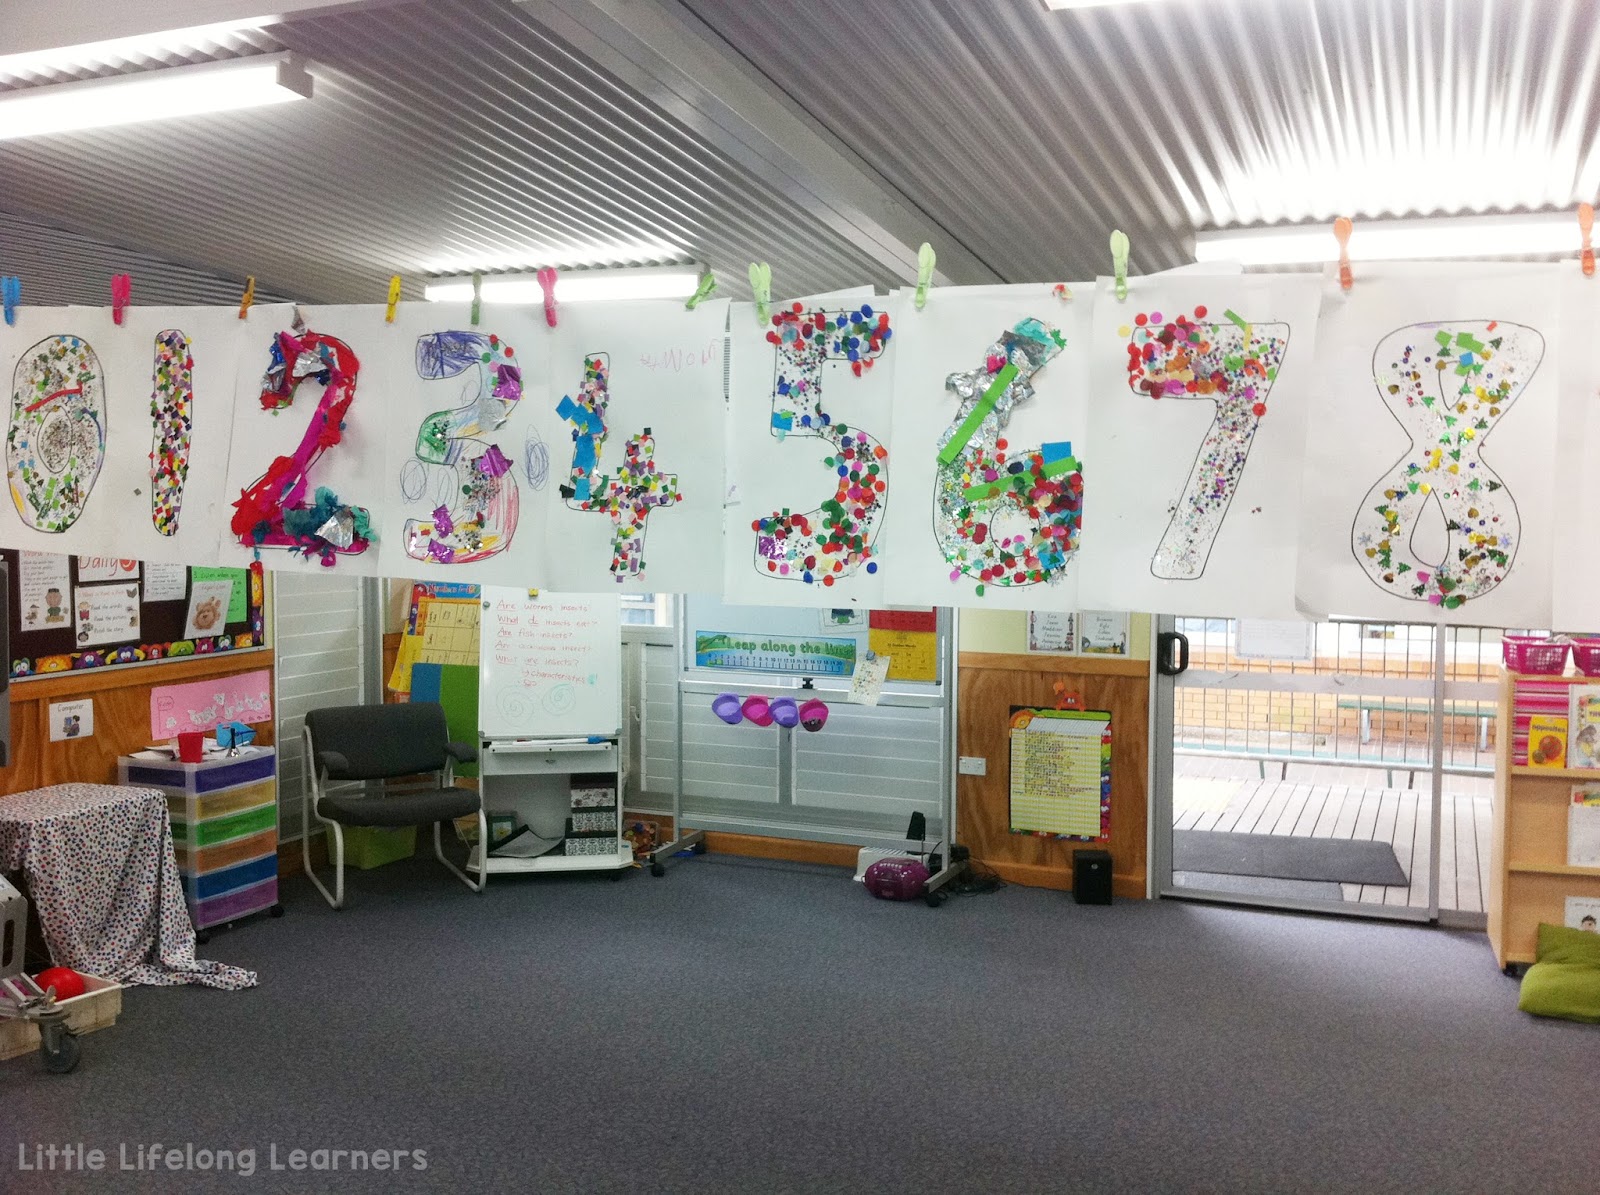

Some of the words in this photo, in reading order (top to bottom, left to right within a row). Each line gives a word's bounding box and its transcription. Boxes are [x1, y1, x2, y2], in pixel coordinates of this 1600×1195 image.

[151, 329, 193, 536] 1
[231, 330, 374, 558] 2
[404, 329, 521, 564] 3
[562, 352, 681, 582] 4
[753, 303, 891, 587] 5
[933, 317, 1083, 587] 6
[1129, 312, 1290, 580] 7
[1351, 319, 1546, 604] 8
[57, 704, 84, 713] Computer
[495, 654, 518, 664] What
[545, 658, 580, 668] insects?
[497, 599, 516, 610] Are
[524, 603, 553, 611] worms
[497, 614, 519, 624] What
[497, 626, 513, 636] Are
[518, 627, 535, 638] fish
[726, 637, 757, 654] Leap
[760, 639, 797, 657] along
[800, 641, 821, 654] the
